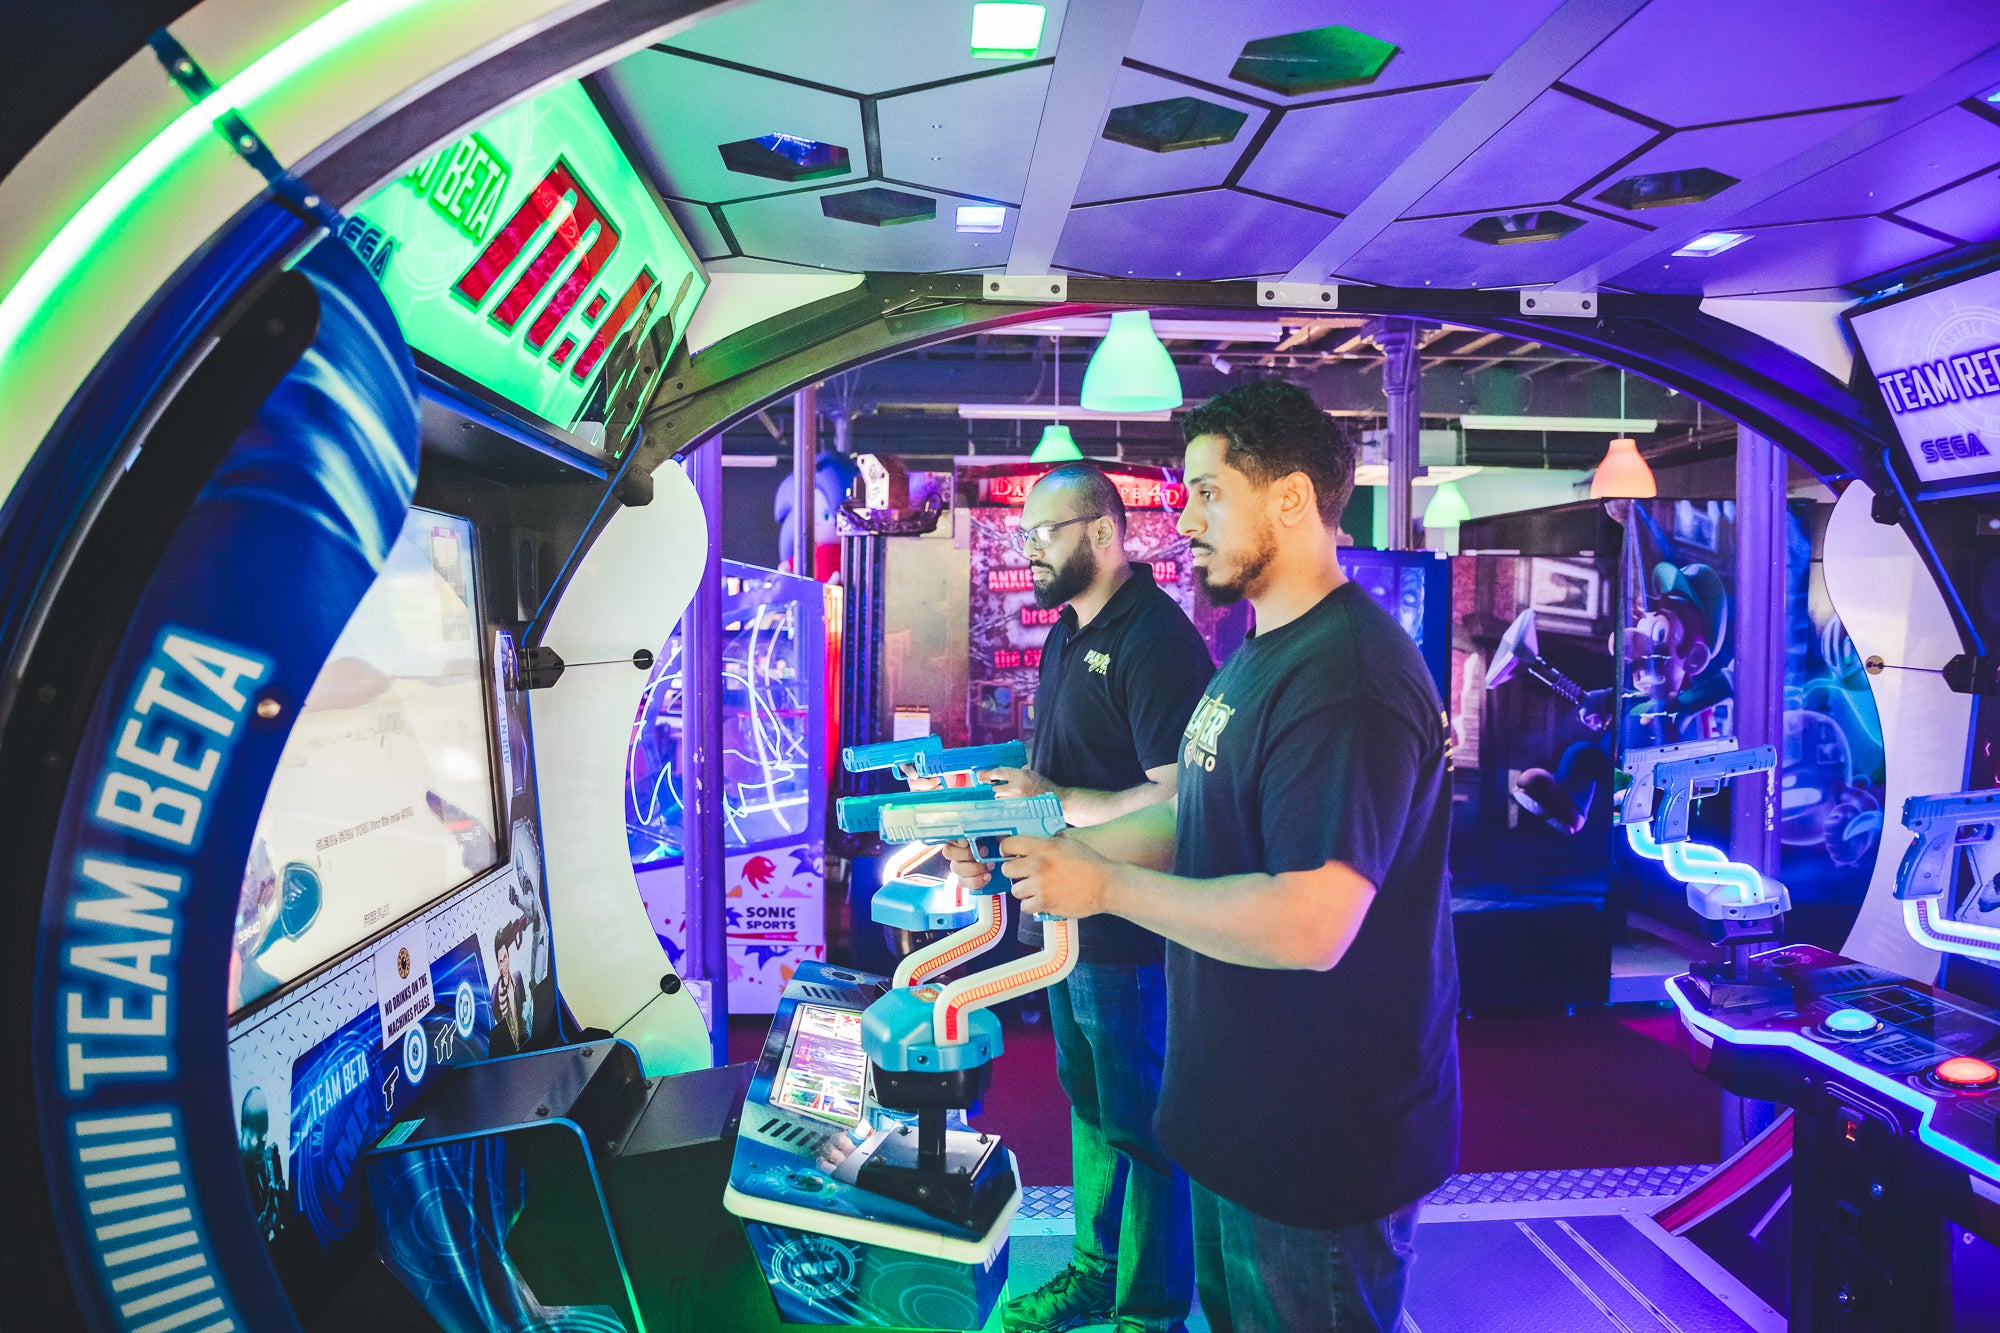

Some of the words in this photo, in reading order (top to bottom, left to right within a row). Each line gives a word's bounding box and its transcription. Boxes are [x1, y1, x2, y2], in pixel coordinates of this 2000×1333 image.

[433, 136, 507, 238] BETA
[340, 216, 393, 282] EGA
[1878, 362, 1958, 412] TEAM
[1921, 433, 1991, 464] SEGA
[988, 570, 1034, 590] ANXIE
[96, 633, 265, 847] BETA
[746, 906, 796, 918] SONIC
[746, 920, 796, 930] SPORTS
[66, 858, 183, 1091] TEAM
[384, 1000, 393, 1017] NO
[392, 985, 412, 1010] DRINKS
[411, 980, 419, 996] ON
[418, 972, 428, 992] THE
[387, 1007, 414, 1039] MACHINES
[413, 993, 431, 1018] PLEASE
[309, 1070, 342, 1121] TEAM
[342, 1050, 370, 1095] BETA
